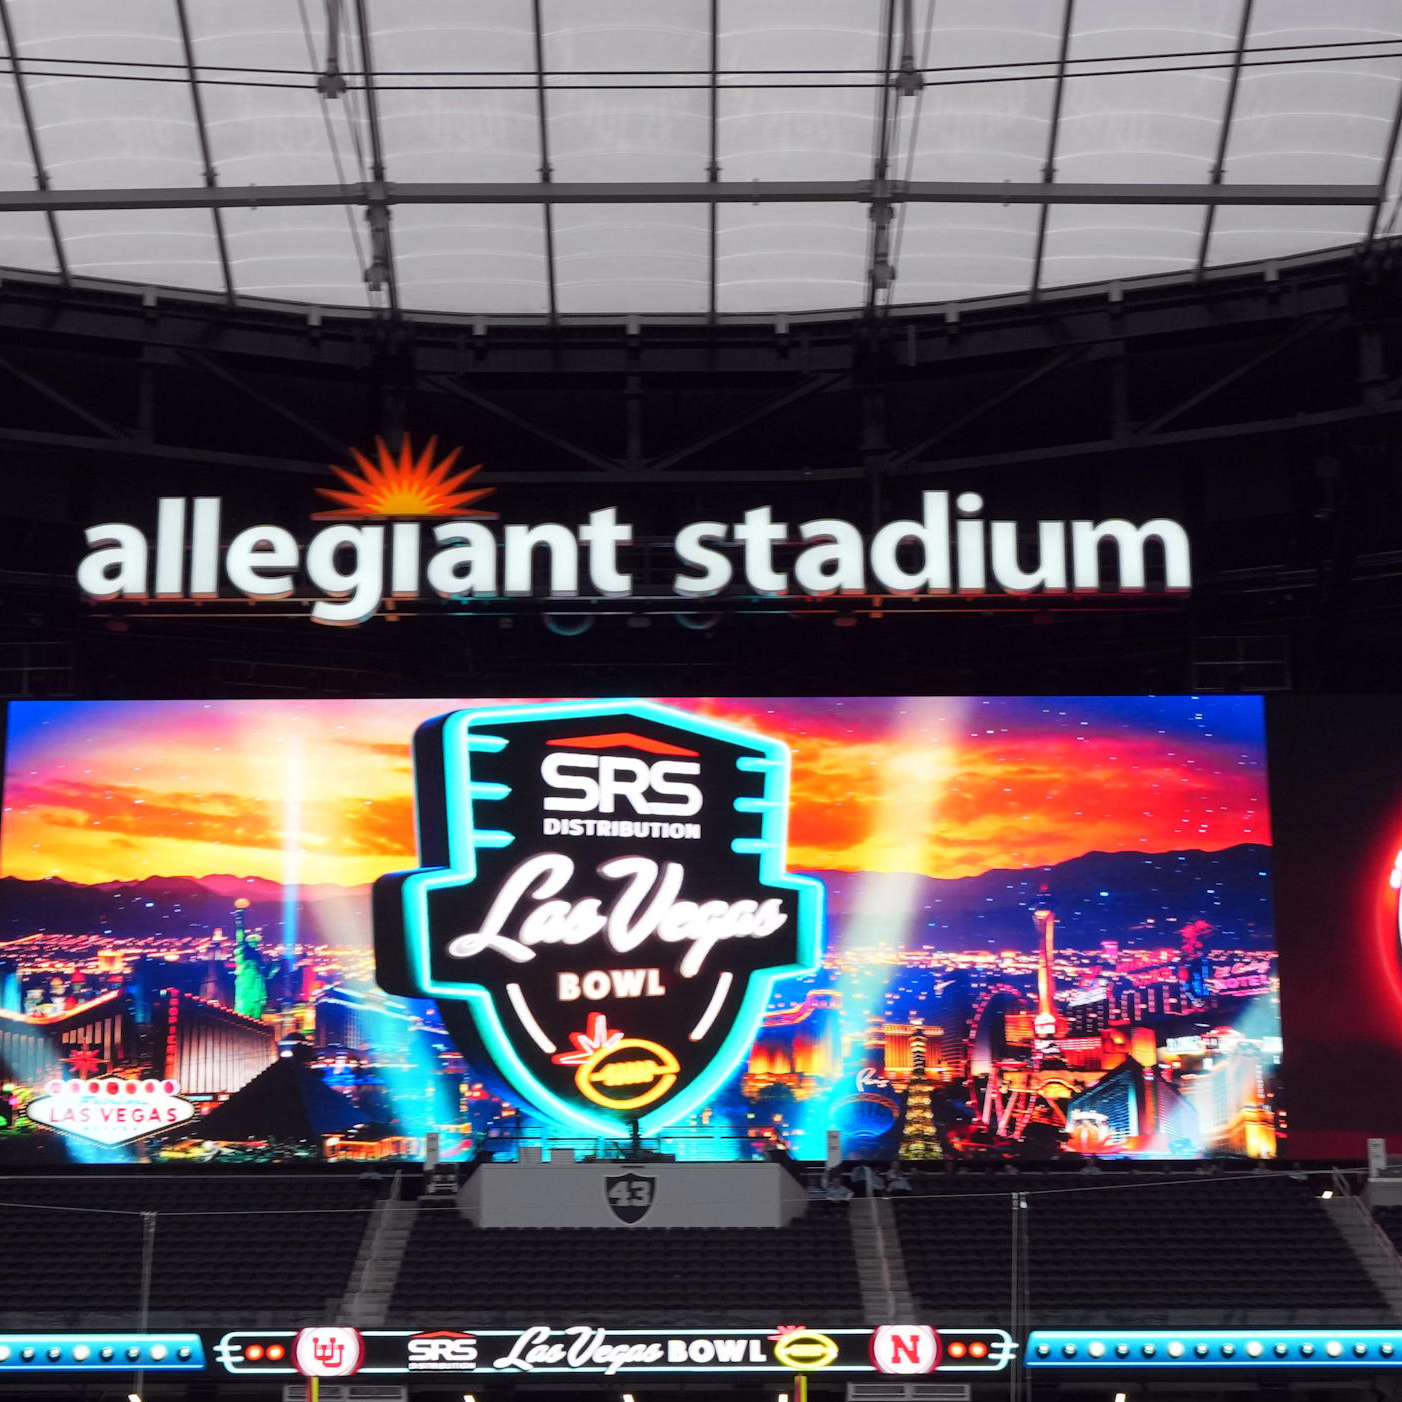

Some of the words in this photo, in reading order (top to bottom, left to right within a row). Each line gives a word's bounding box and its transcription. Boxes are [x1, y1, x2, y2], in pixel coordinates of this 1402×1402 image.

[77, 496, 634, 624] allegiant
[673, 490, 1192, 593] stadium
[541, 752, 703, 816] SRS
[543, 818, 701, 840] DISTRIBUTION
[448, 853, 608, 963] Las
[597, 856, 788, 978] Vegas
[558, 968, 666, 1001] BOWL
[50, 1107, 90, 1122] LAS
[99, 1107, 178, 1122] VEGAS
[609, 1180, 652, 1207] 43
[408, 1338, 478, 1361] SRS
[492, 1325, 567, 1371] Las
[563, 1326, 665, 1375] Vegas
[668, 1339, 767, 1362] BOWL
[890, 1334, 920, 1364] N
